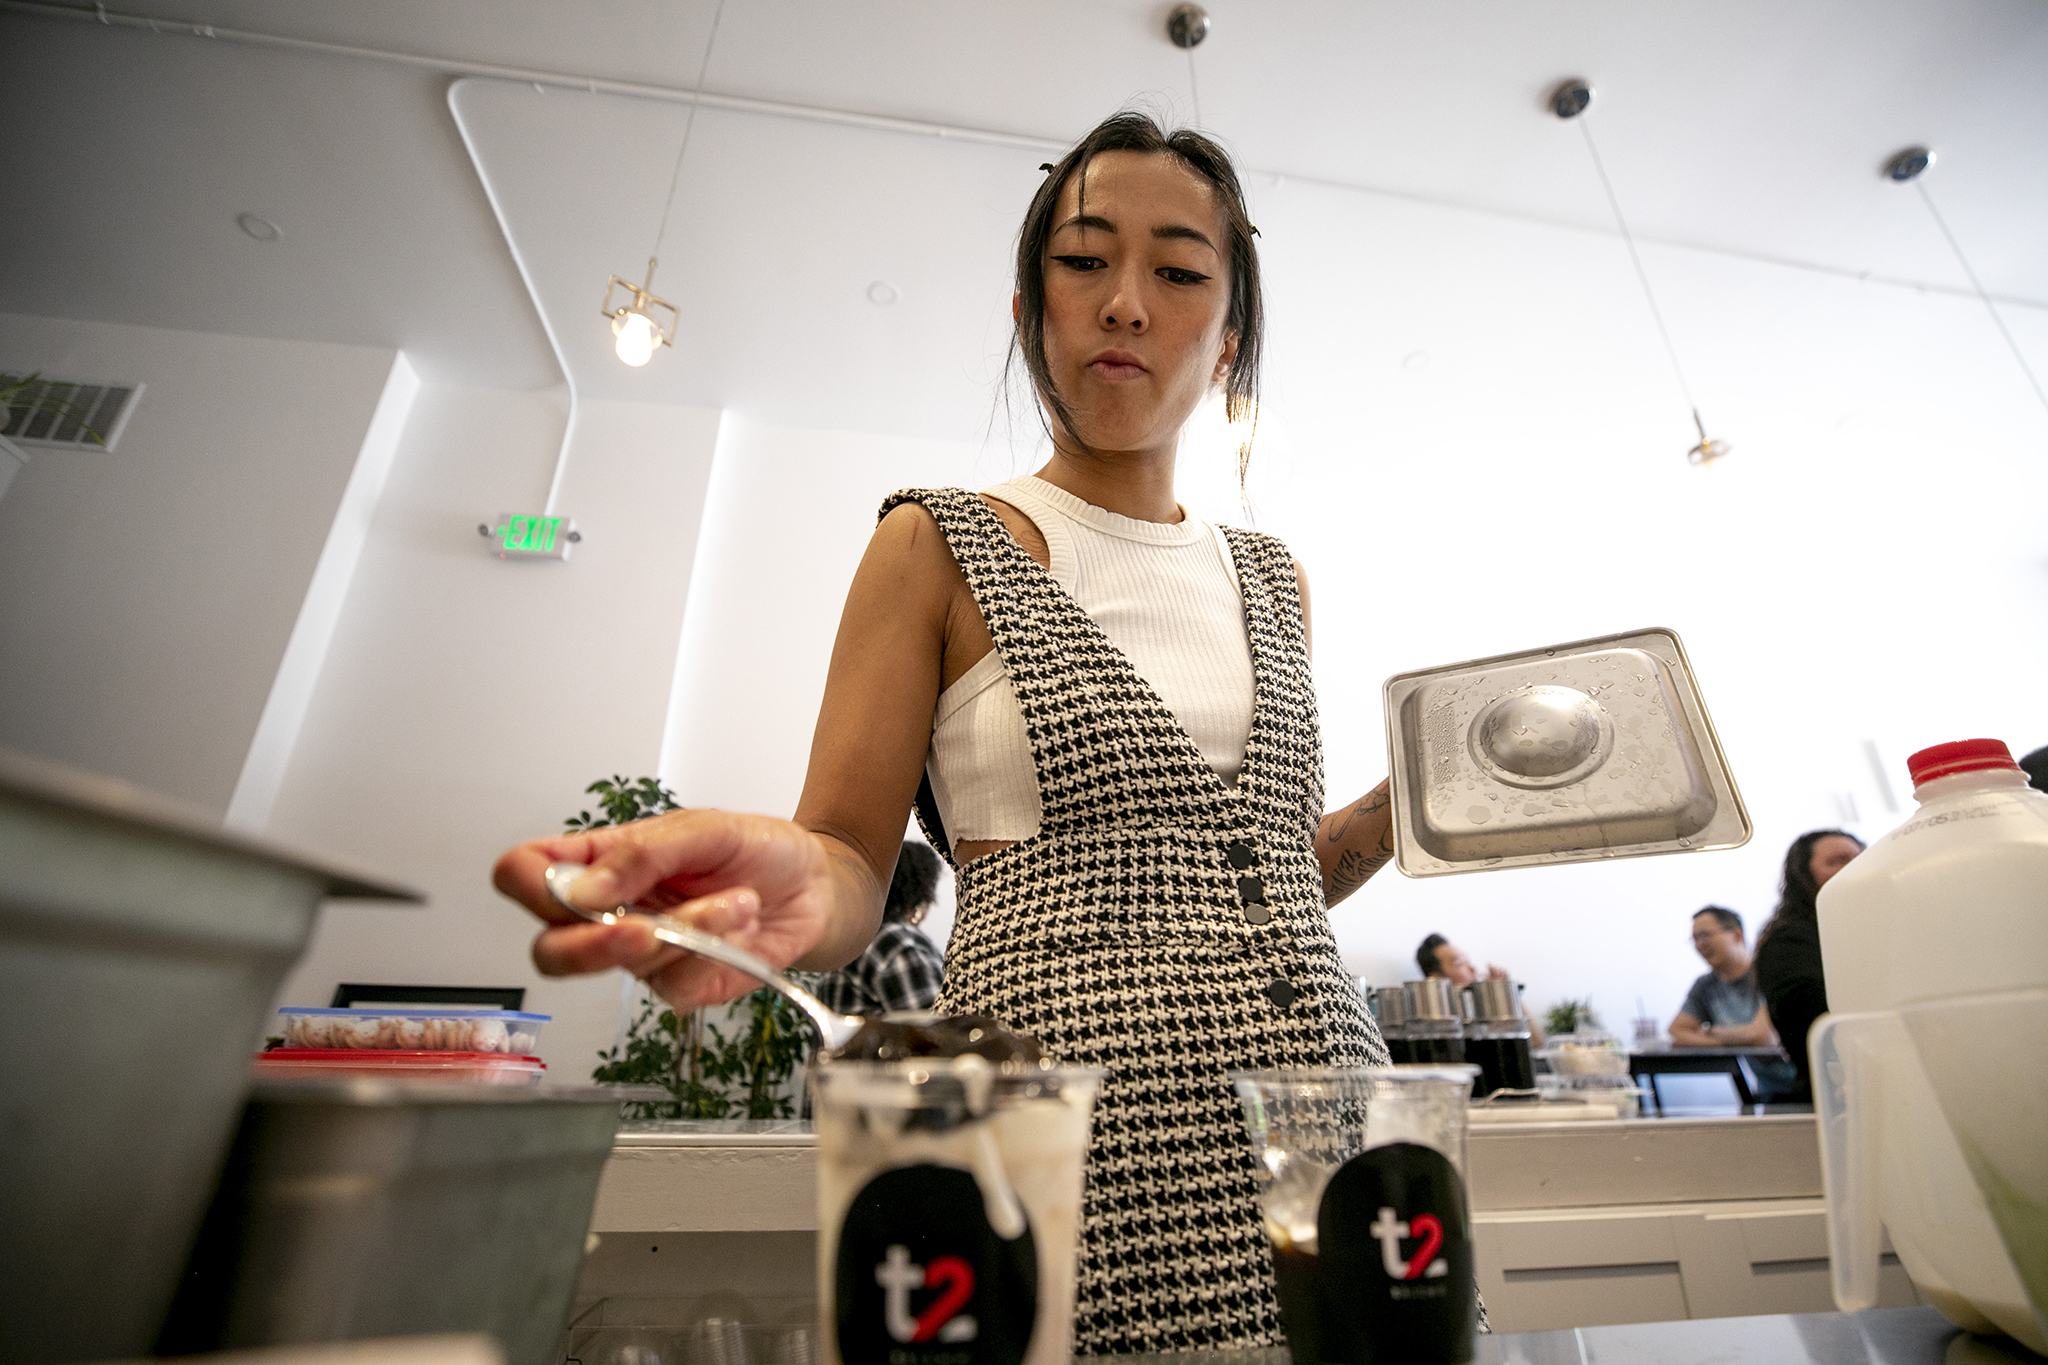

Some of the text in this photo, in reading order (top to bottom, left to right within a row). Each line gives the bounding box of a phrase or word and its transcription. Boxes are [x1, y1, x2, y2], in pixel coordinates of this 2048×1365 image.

[504, 515, 562, 551] EXIT
[1370, 1207, 1449, 1279] t2
[874, 1244, 978, 1343] t2
